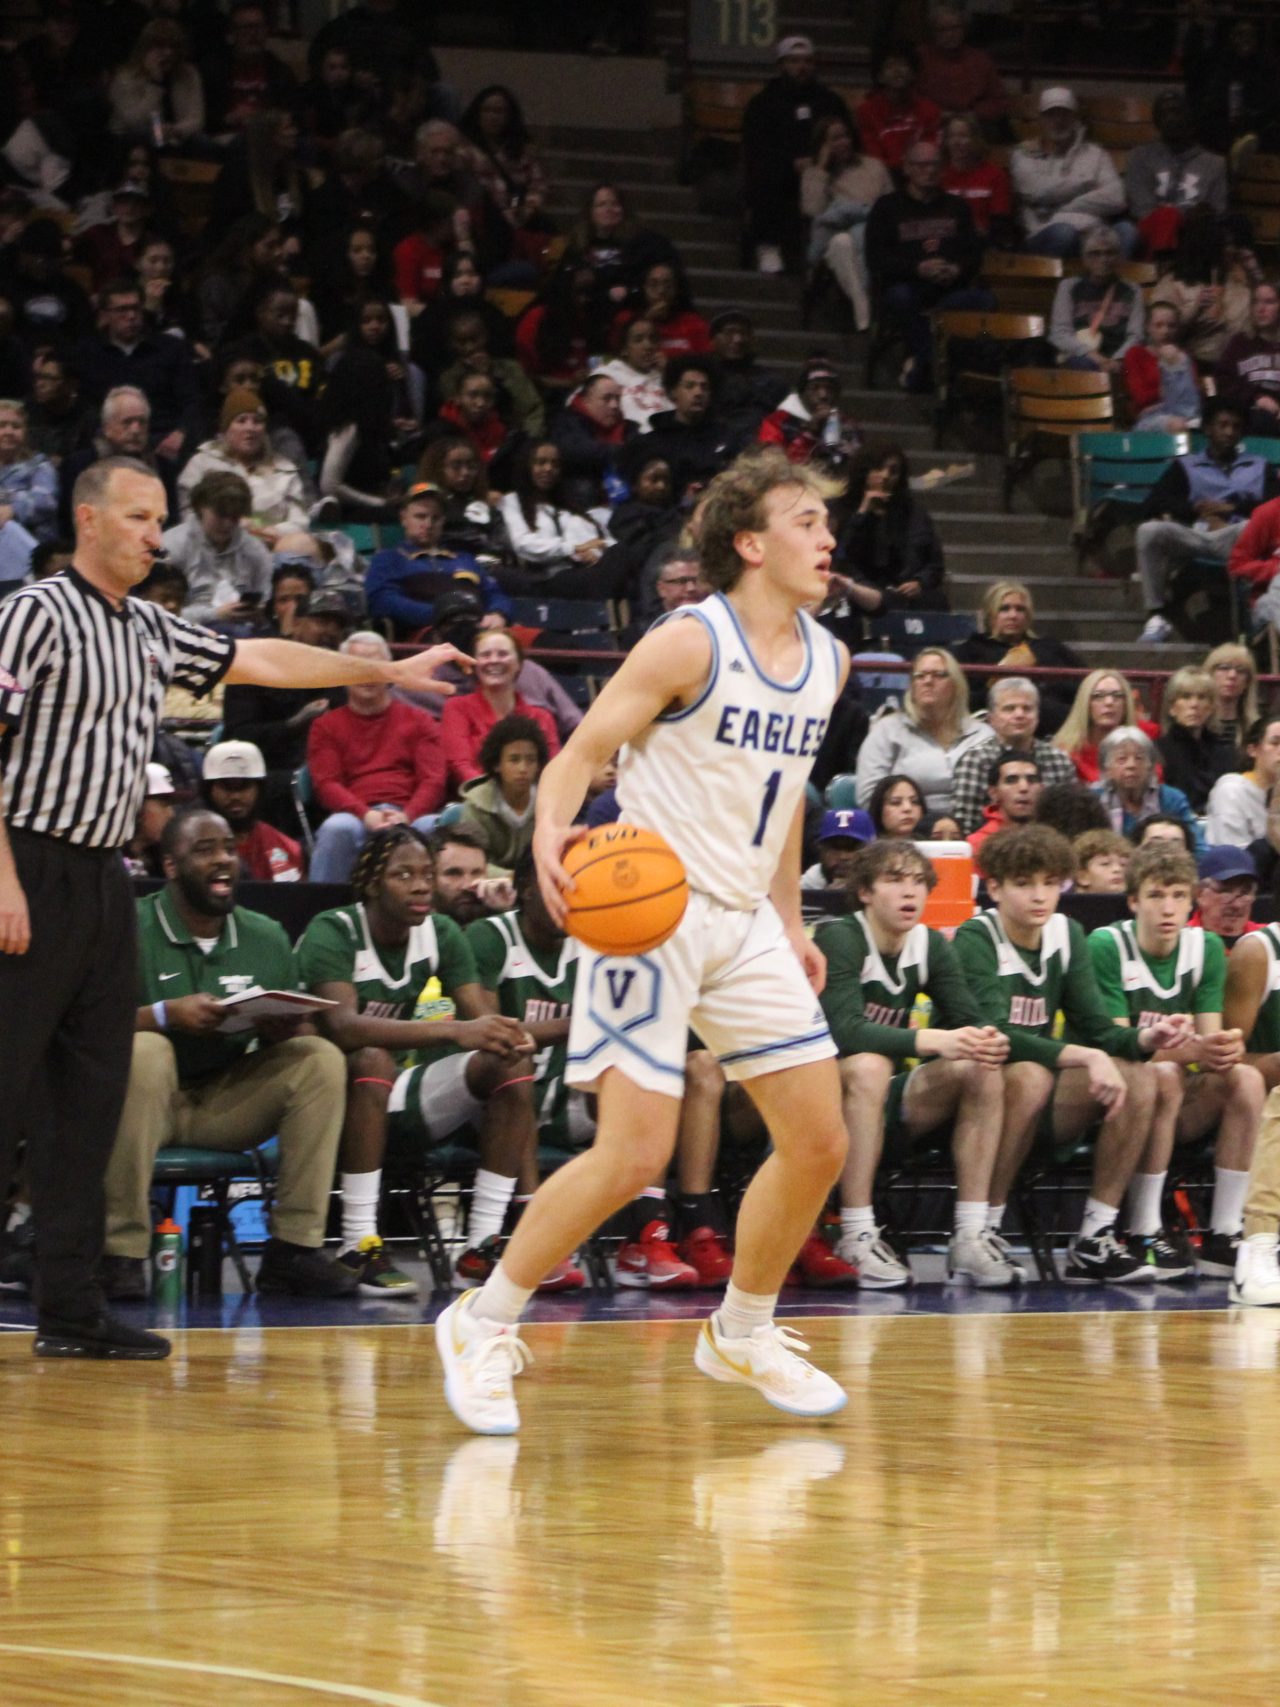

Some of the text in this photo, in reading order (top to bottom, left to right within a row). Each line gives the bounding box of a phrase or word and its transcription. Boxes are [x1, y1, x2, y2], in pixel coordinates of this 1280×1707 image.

[719, 0, 777, 48] 113
[752, 769, 784, 847] 1
[835, 810, 855, 828] T
[605, 968, 637, 1010] V
[155, 1249, 177, 1271] G
